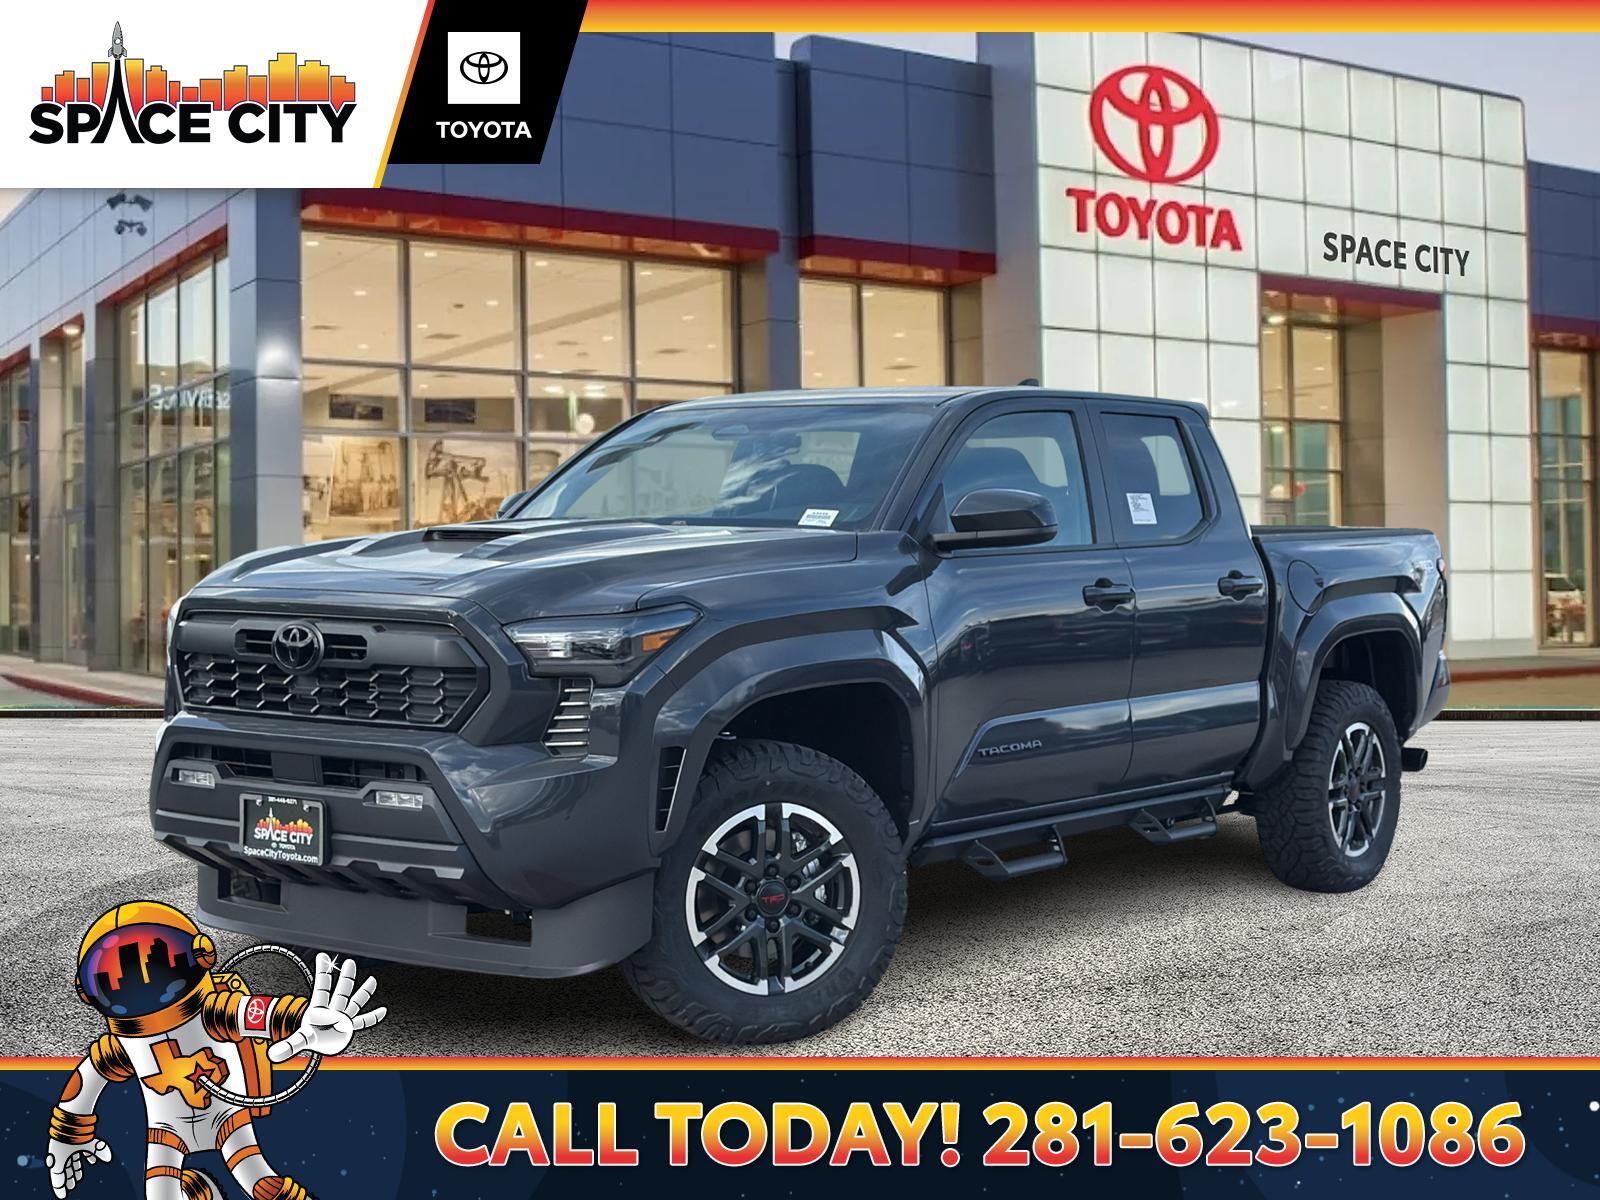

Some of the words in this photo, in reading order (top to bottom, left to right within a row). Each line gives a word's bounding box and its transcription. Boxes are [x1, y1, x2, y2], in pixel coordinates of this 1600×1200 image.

[1065, 187, 1243, 252] TOYOTA
[1322, 231, 1407, 270] SPACE
[1414, 244, 1471, 277] CITY
[977, 740, 1044, 757] TACOMA
[253, 824, 288, 842] SPACE
[289, 832, 314, 846] CITY
[243, 845, 319, 864] SpaceCityToyota.com
[278, 843, 296, 851] TOYOTA
